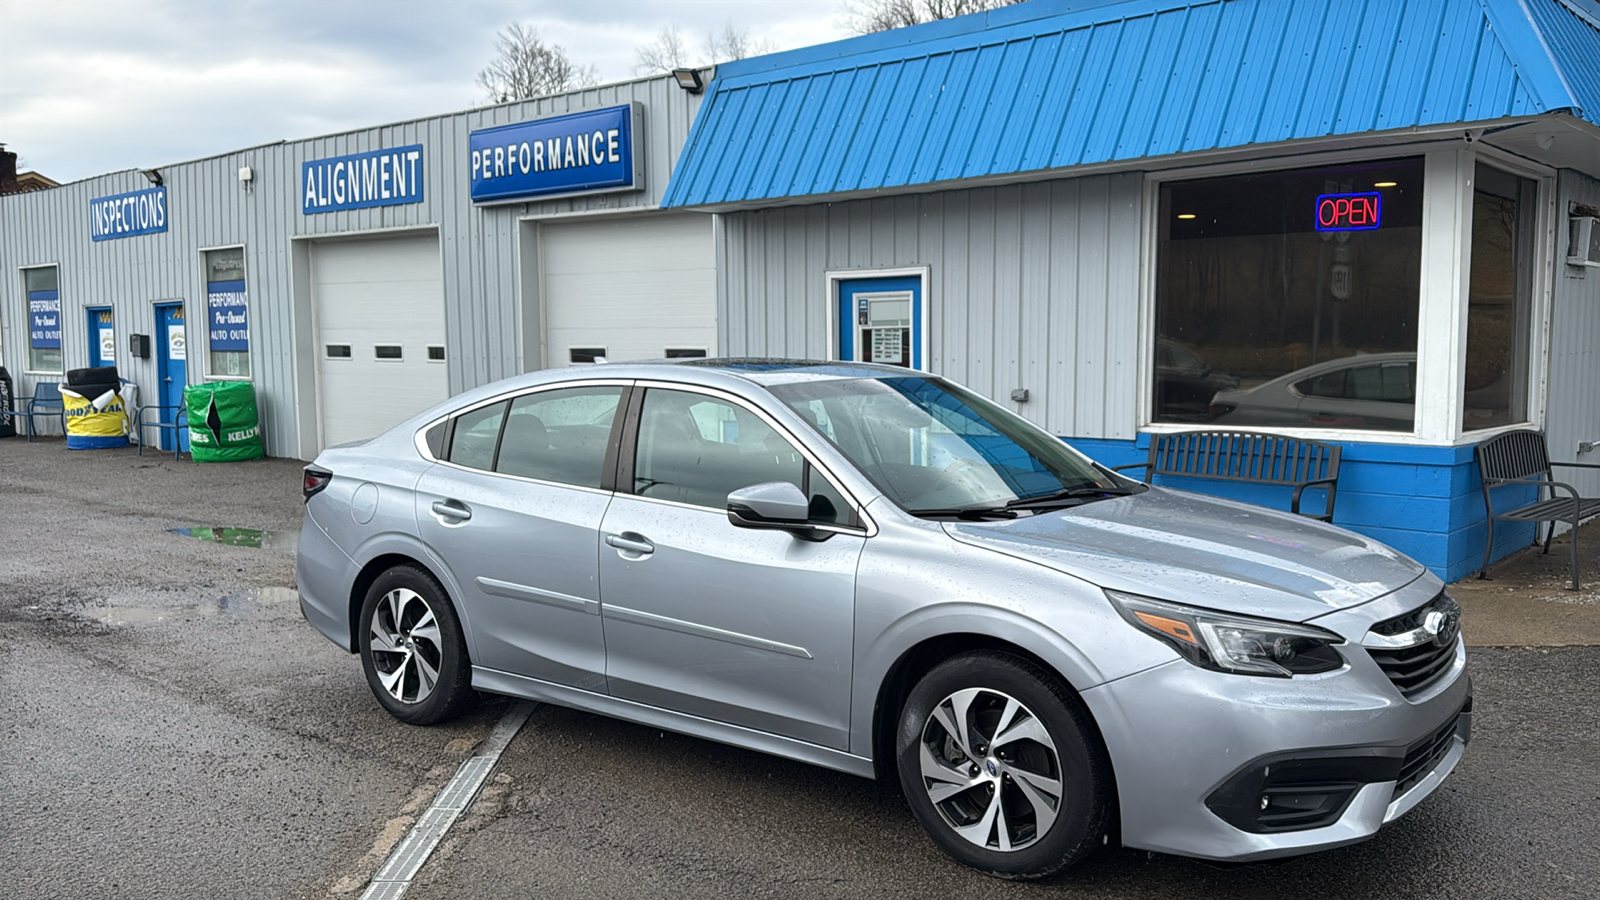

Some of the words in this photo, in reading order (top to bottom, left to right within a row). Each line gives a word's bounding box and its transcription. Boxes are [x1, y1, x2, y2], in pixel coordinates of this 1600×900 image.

[472, 129, 620, 180] PERFORMANCE
[305, 150, 419, 208] ALIGNMENT
[91, 191, 164, 237] INSPECTIONS
[1319, 197, 1378, 226] OPEN
[30, 299, 60, 312] PERFORMANCE
[209, 292, 248, 307] PERFORMANC
[35, 315, 56, 326] Pre-Owned
[215, 310, 246, 325] Pre-Owned
[32, 331, 44, 339] AUTO
[211, 330, 227, 340] AUTO
[230, 329, 249, 340] OUTL
[228, 427, 254, 442] KELLY
